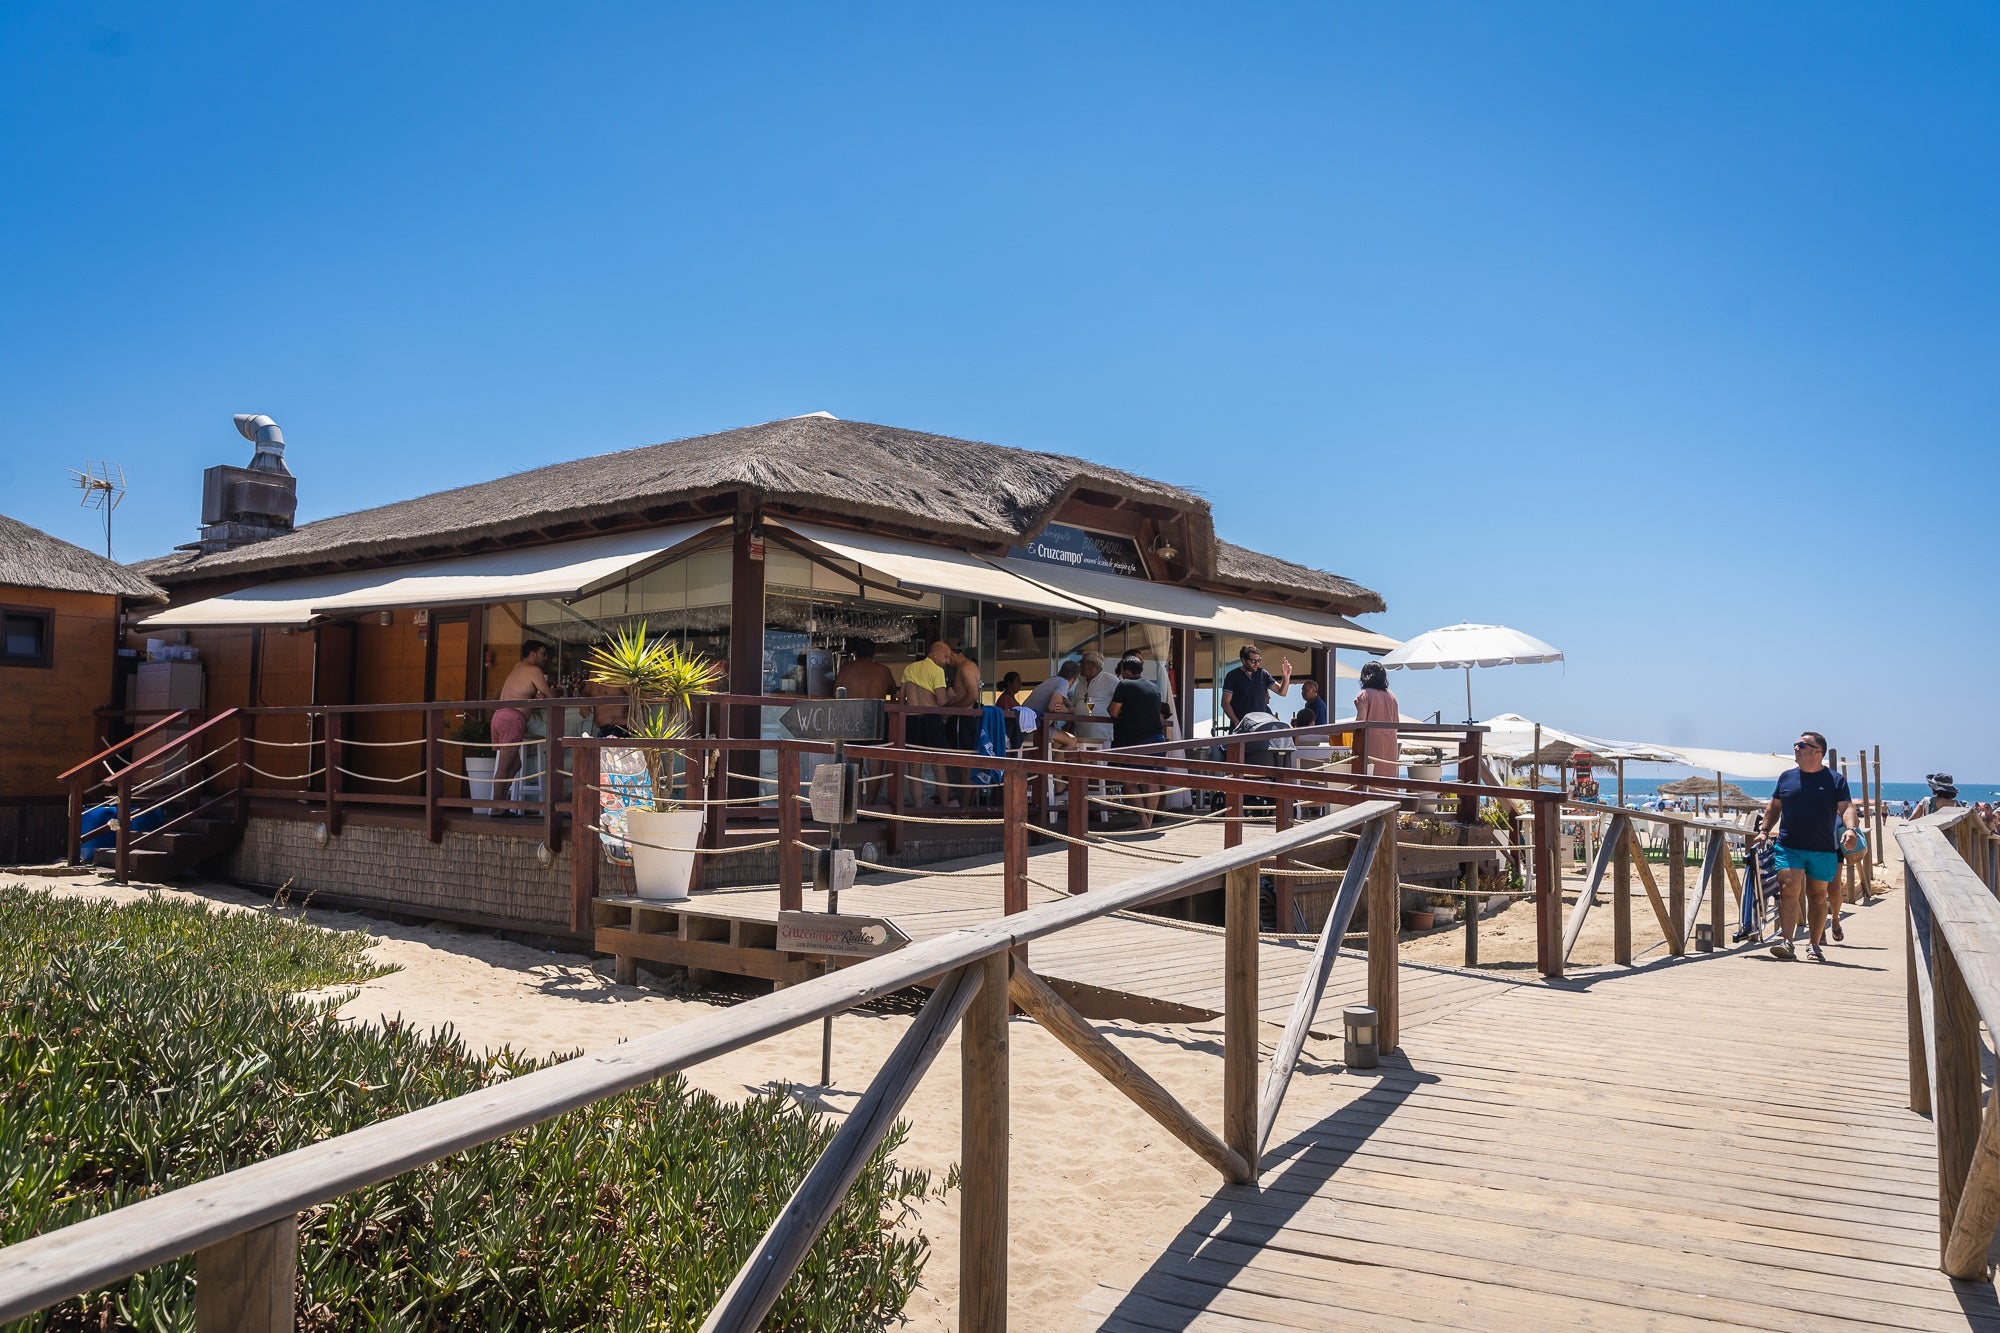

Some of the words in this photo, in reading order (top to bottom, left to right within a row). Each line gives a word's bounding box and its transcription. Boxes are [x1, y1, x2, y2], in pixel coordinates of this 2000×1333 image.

[1038, 544, 1082, 565] Cruzcampo
[796, 707, 825, 731] WC
[781, 925, 838, 942] Cruzcampo
[840, 929, 875, 946] Radler
